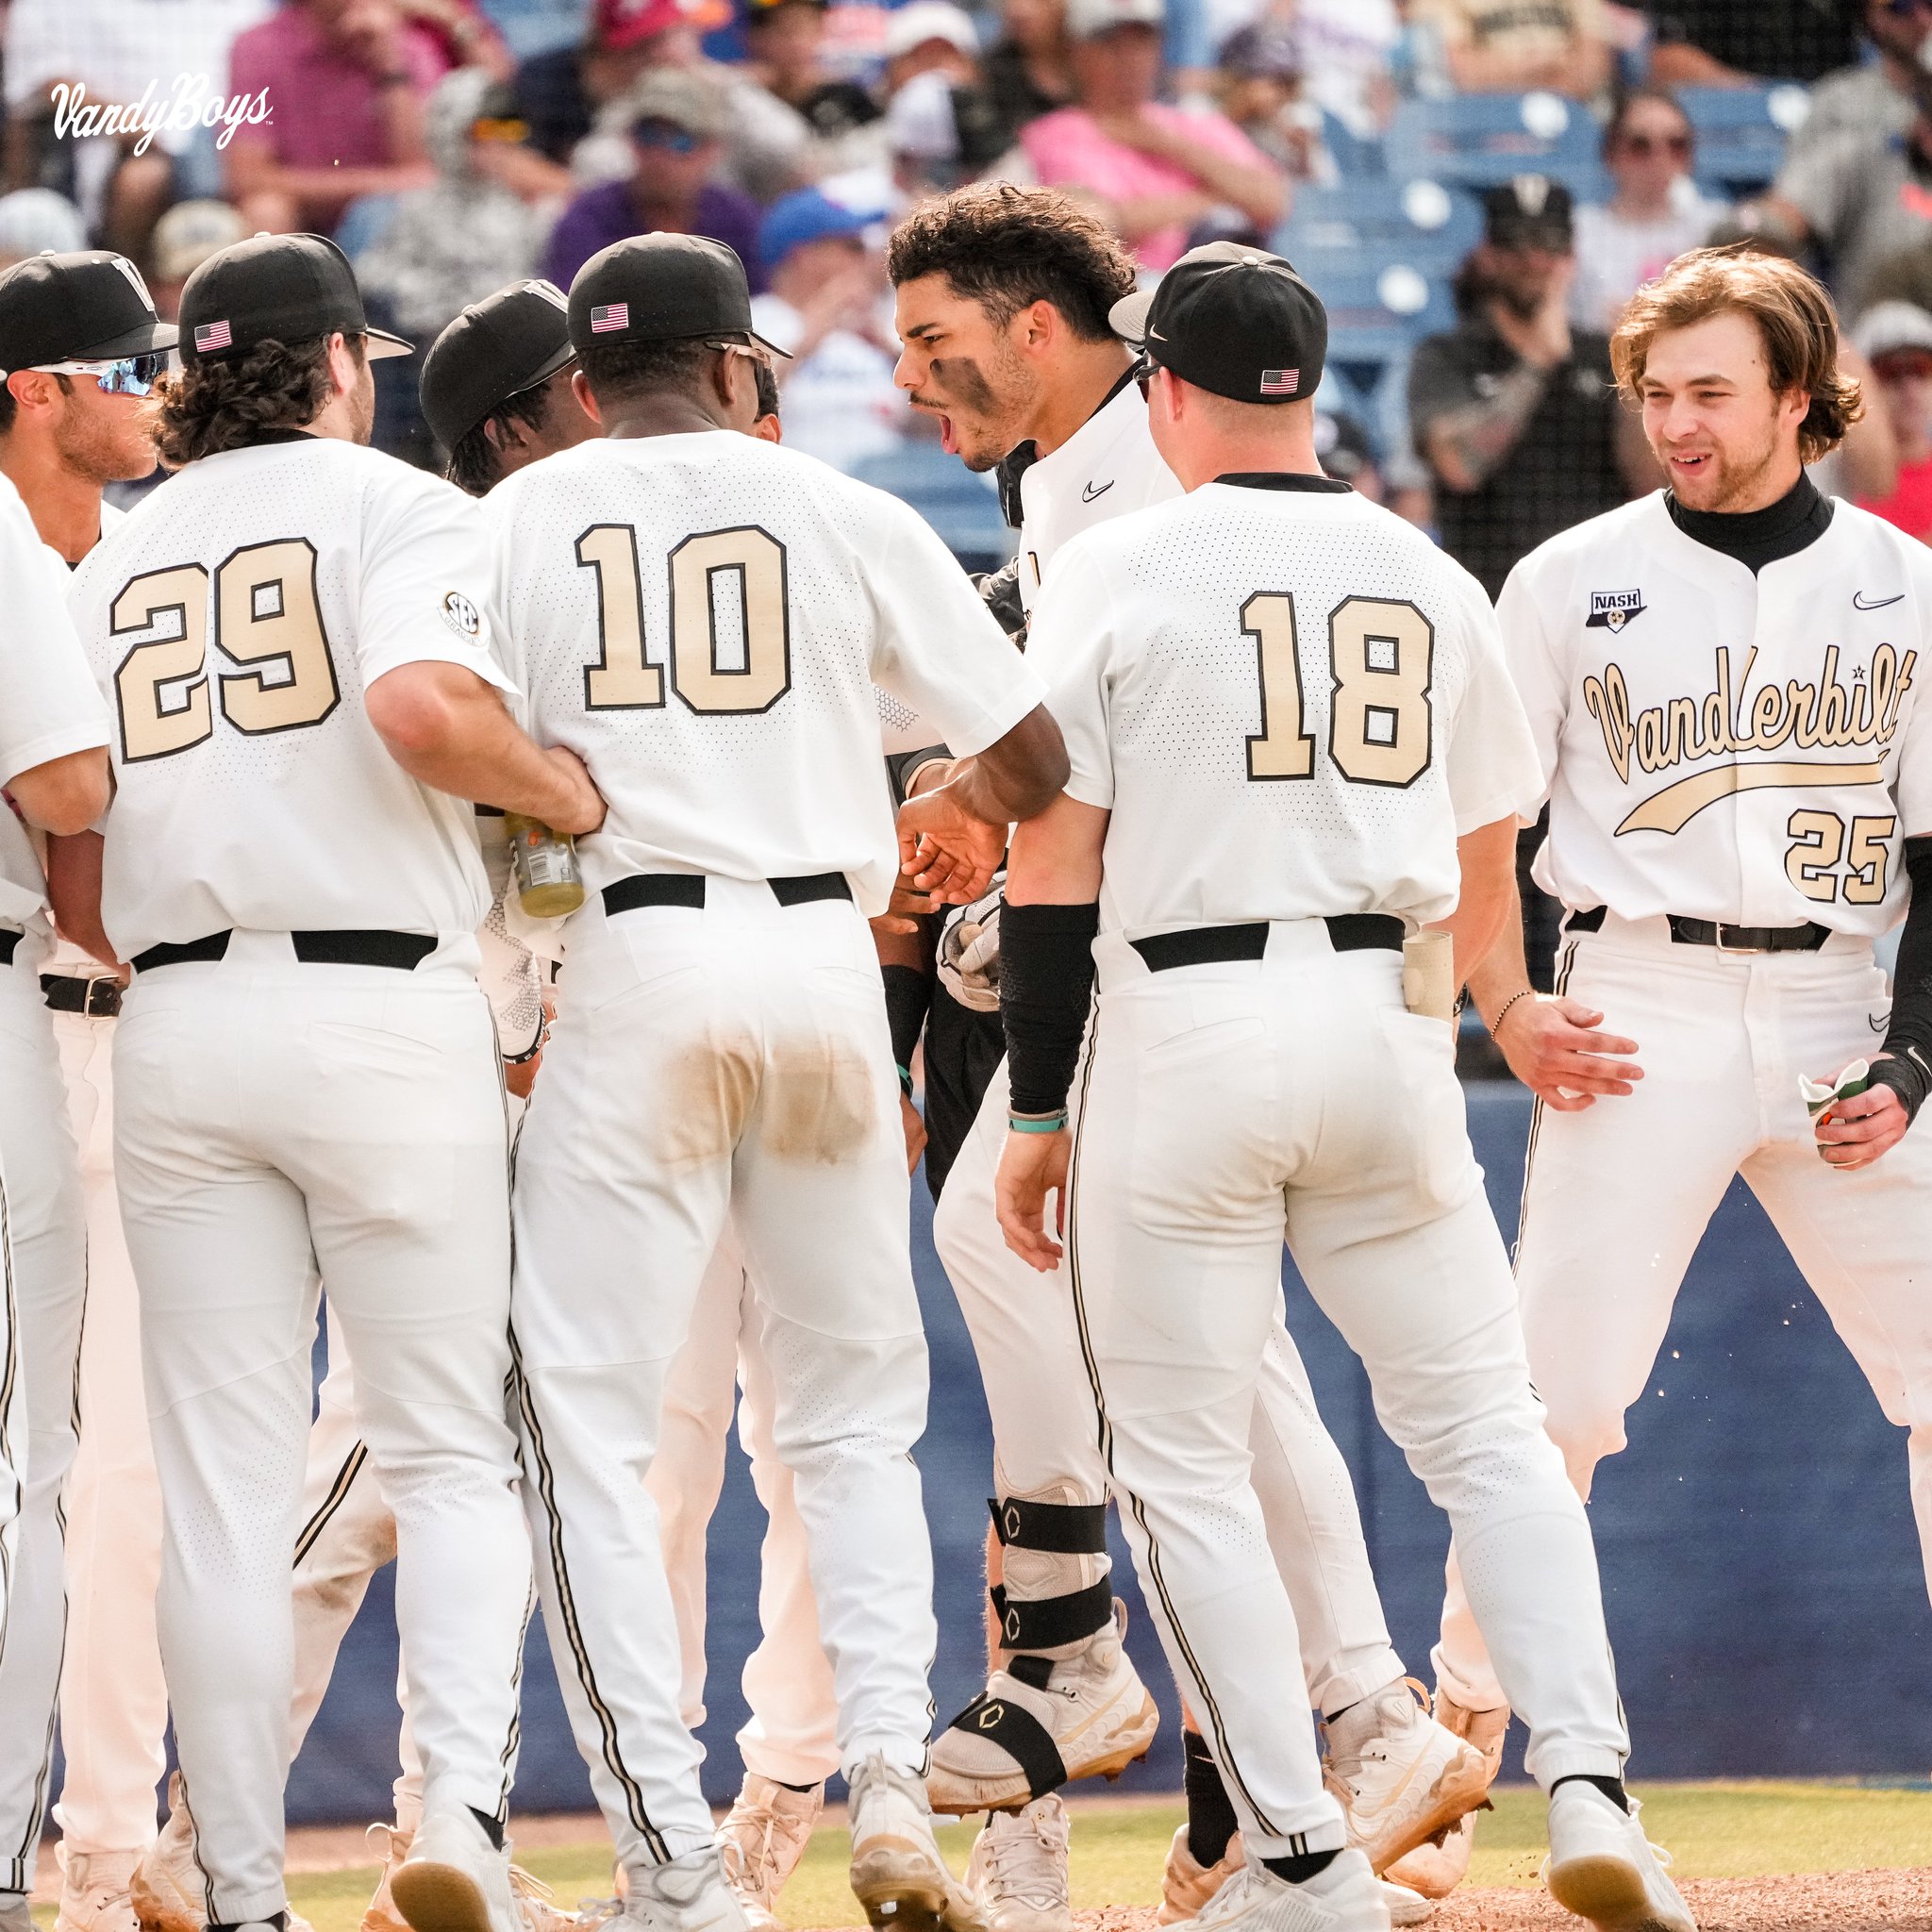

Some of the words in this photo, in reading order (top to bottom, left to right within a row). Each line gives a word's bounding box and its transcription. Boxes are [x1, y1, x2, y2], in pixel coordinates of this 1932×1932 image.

[109, 537, 341, 765] 29
[446, 592, 478, 634] SEC
[574, 524, 791, 716] 10
[1594, 593, 1639, 609] NASH
[1239, 591, 1435, 790] 18
[1584, 643, 1918, 785] Vanderbilt
[1784, 808, 1897, 906] 25
